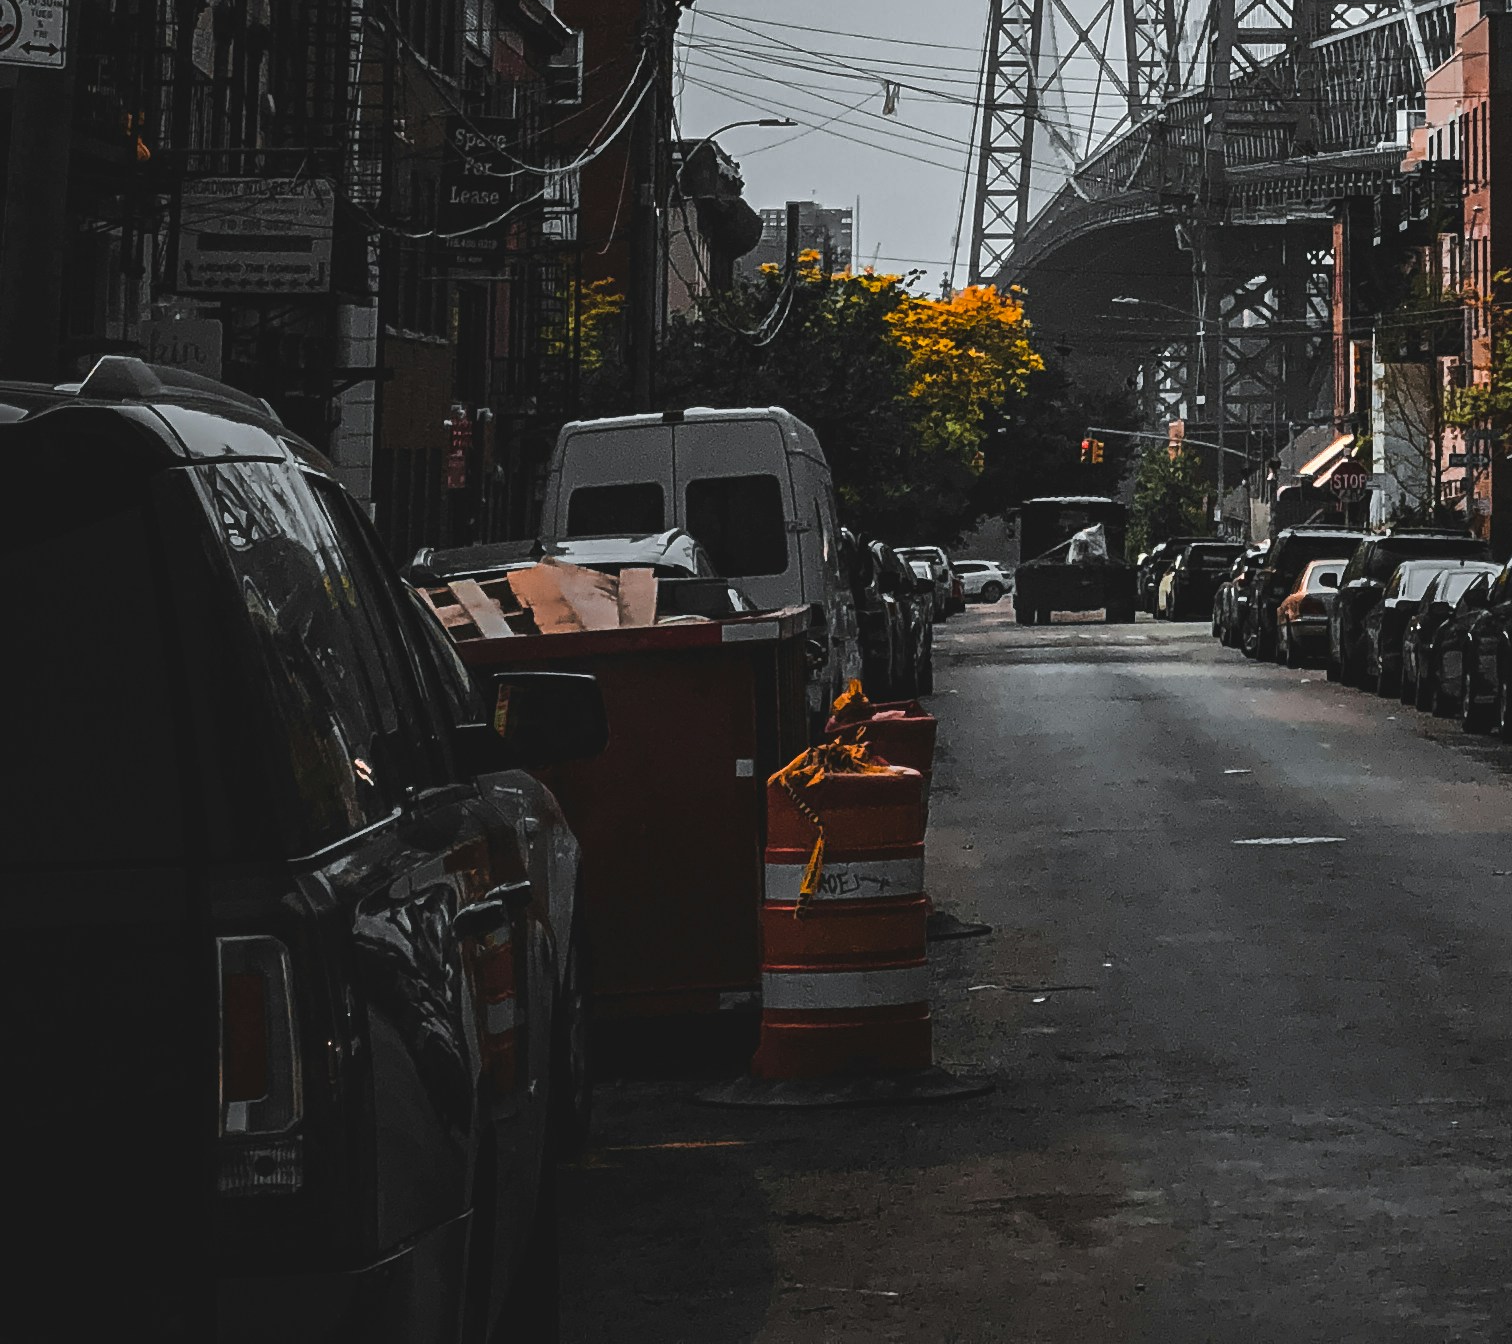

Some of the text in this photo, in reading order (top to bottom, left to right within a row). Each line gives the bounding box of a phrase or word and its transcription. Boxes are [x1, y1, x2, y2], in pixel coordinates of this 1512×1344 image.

[464, 157, 493, 176] For
[449, 185, 500, 205] Lease
[1333, 473, 1367, 490] STOP
